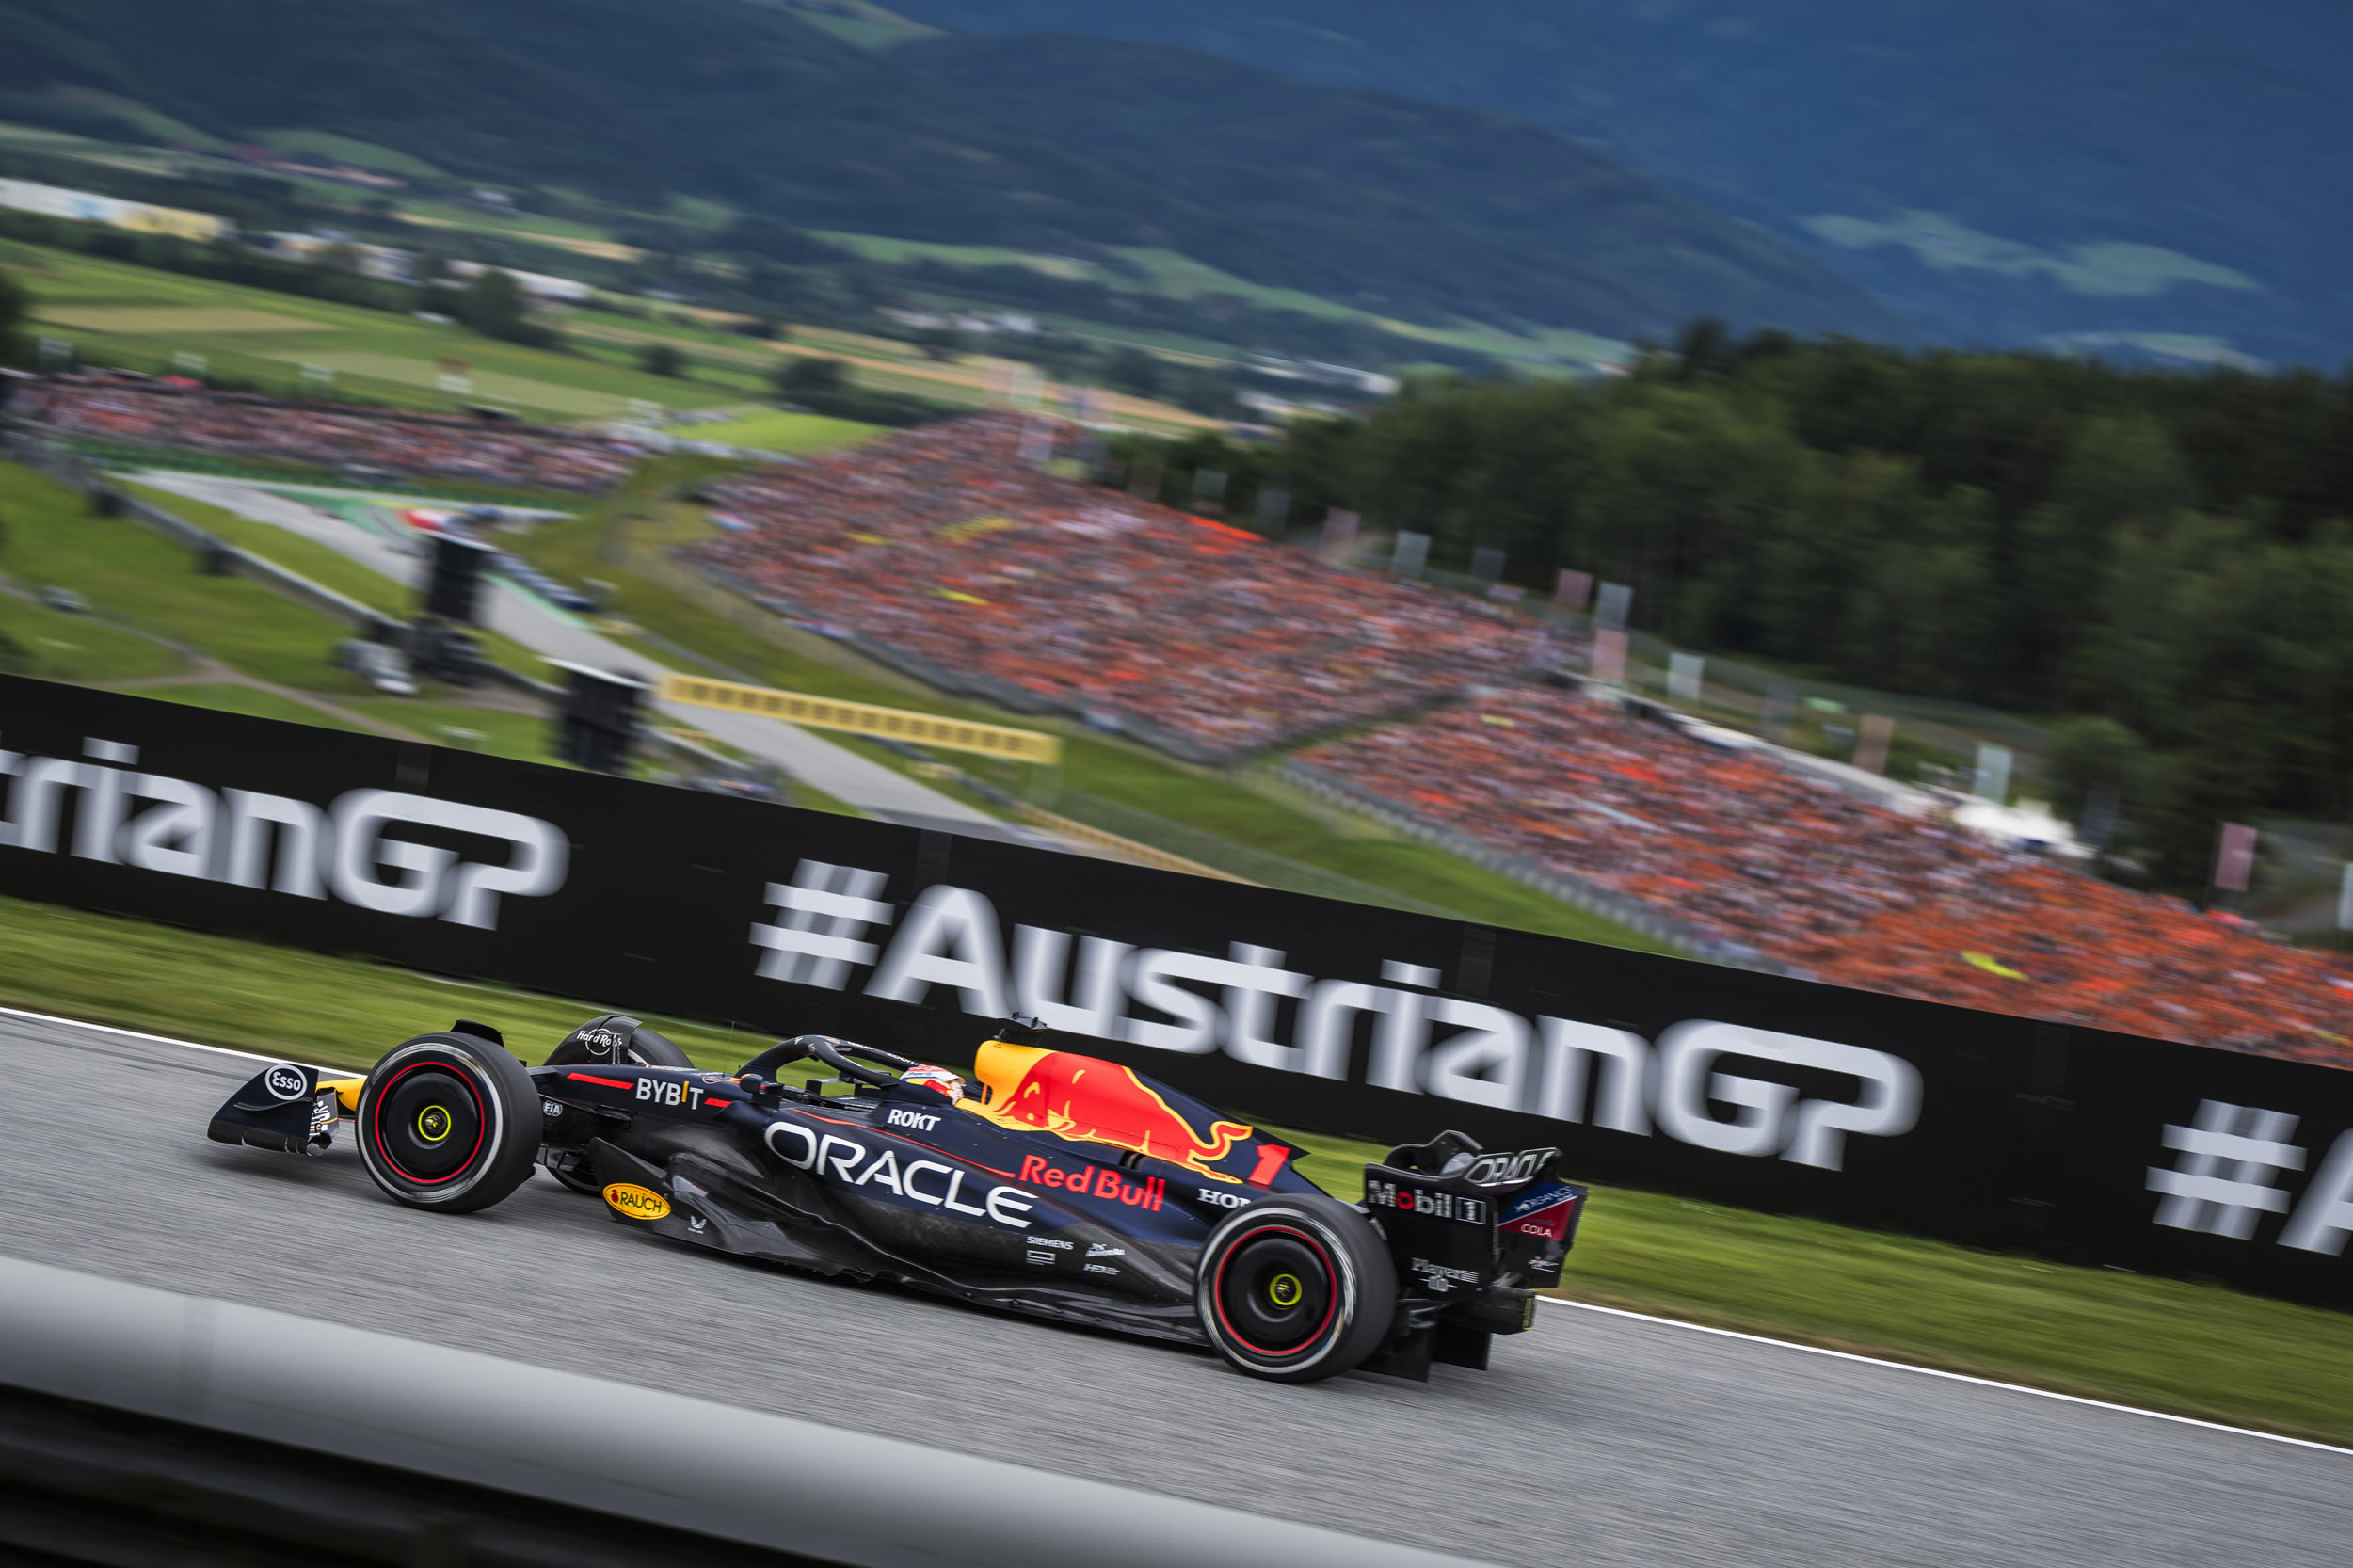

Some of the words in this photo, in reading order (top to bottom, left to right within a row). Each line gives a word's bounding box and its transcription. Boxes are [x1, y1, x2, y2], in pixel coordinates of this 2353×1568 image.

[0, 736, 570, 930] rianGP
[749, 858, 1923, 1173] #AustrianGP
[543, 1103, 561, 1114] FIA
[635, 1077, 704, 1110] BYBIT
[887, 1108, 942, 1131] ROKT
[763, 1120, 1040, 1229] ORACLE
[1247, 1144, 1291, 1185] 1
[1018, 1154, 1096, 1193] Red
[1093, 1169, 1166, 1212] Bull
[1368, 1180, 1452, 1218] Mobil
[620, 1192, 662, 1213] RAUCH
[1026, 1236, 1074, 1251] SIEMENS
[1521, 1224, 1552, 1238] COLA
